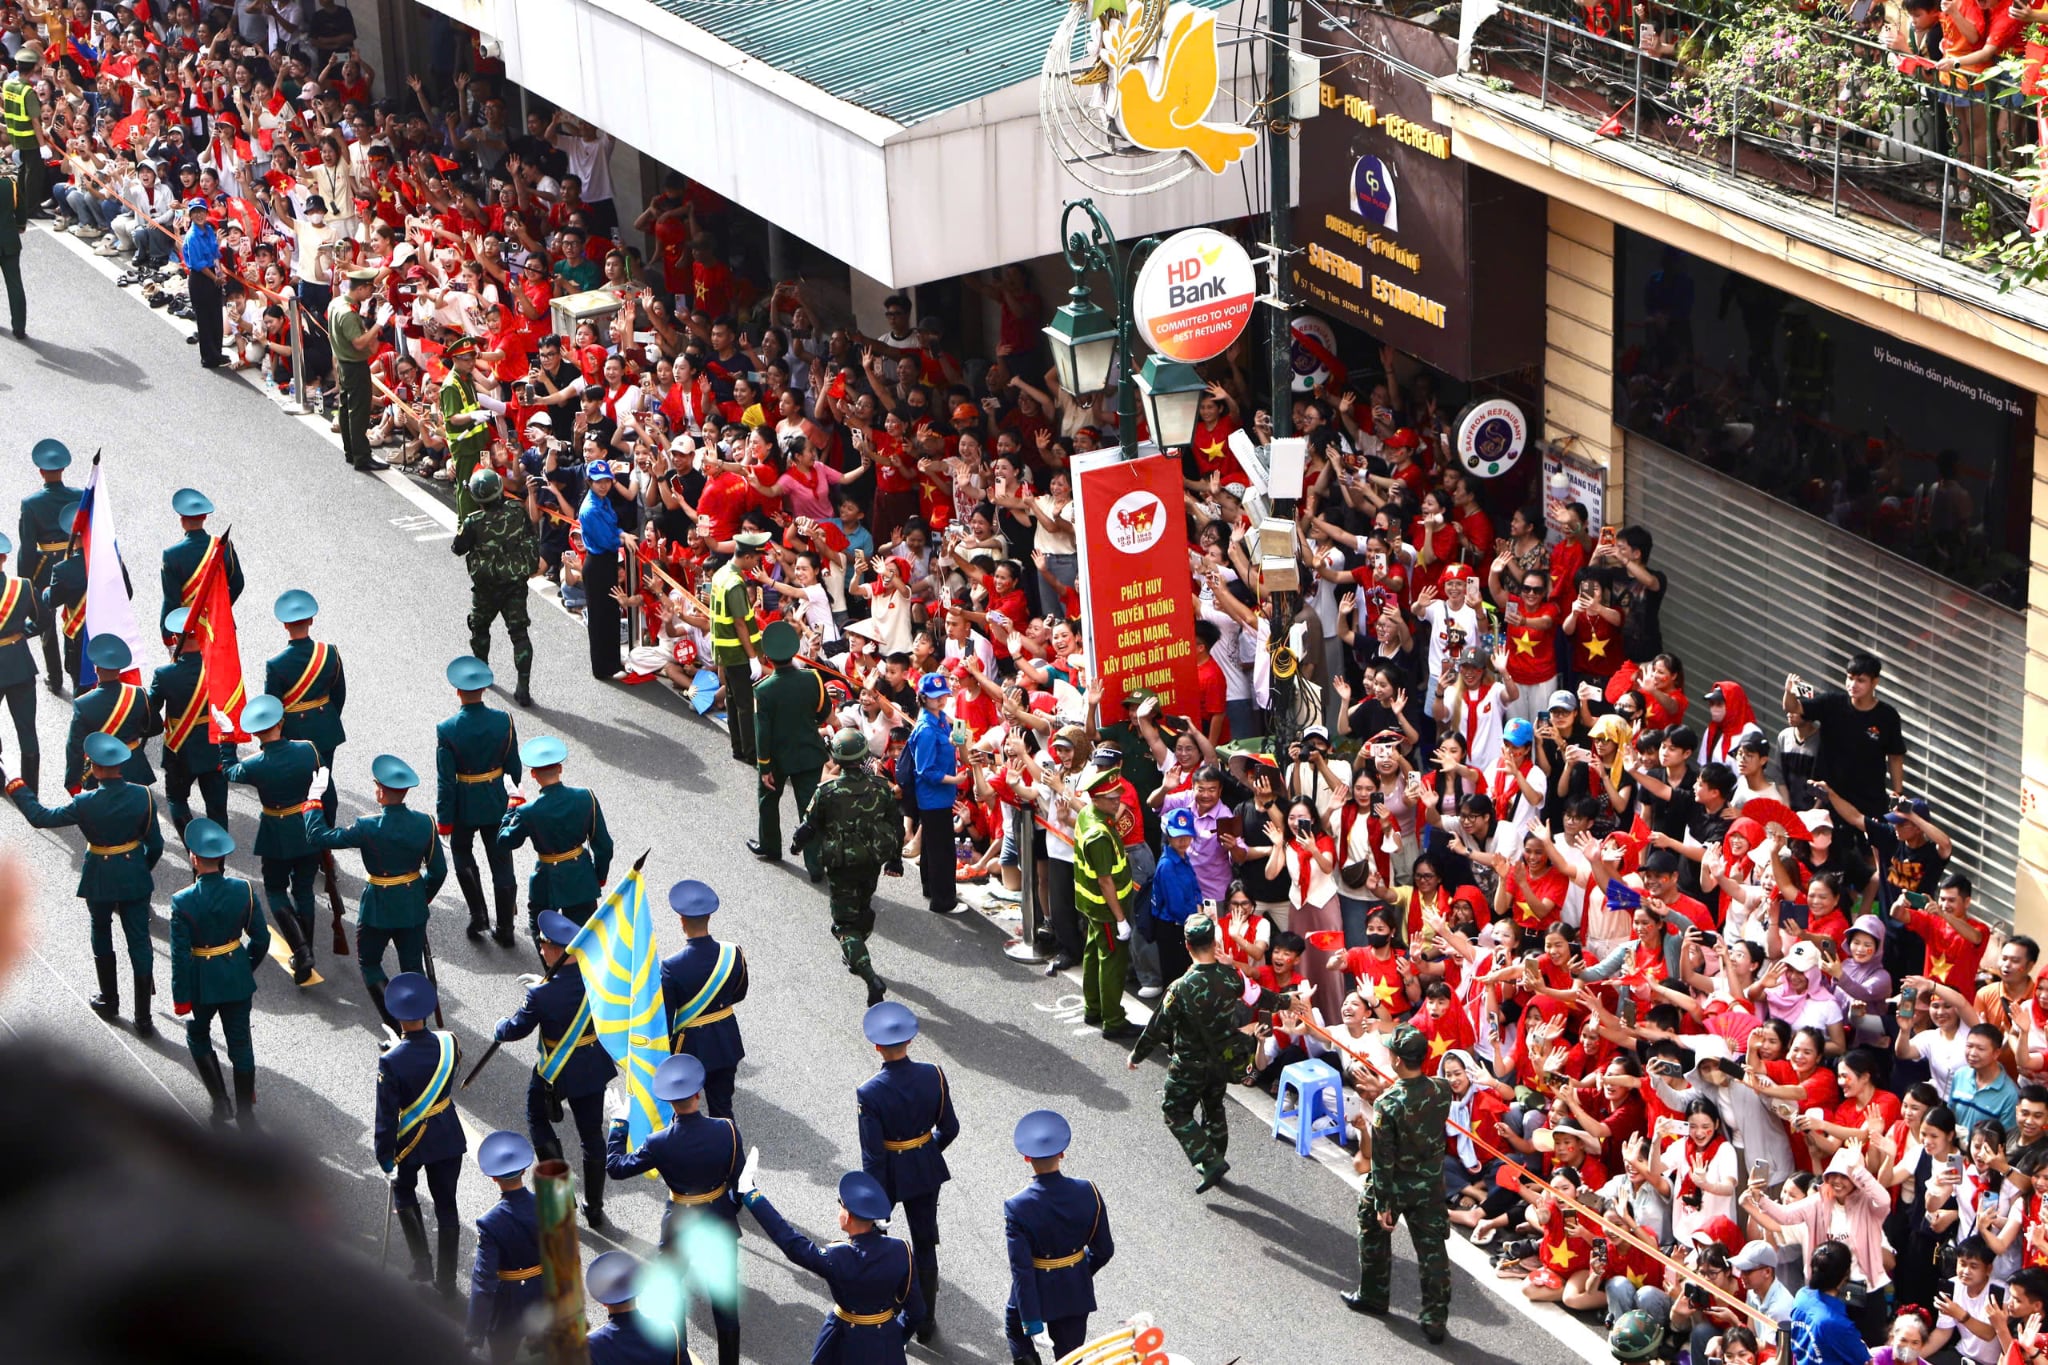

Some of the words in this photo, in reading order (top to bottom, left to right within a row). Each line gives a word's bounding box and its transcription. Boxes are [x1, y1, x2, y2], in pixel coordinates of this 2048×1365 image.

[1320, 81, 1336, 109] EL
[1344, 94, 1376, 128] FOOD
[1385, 113, 1450, 159] ICECREAM
[1167, 257, 1202, 285] HD
[1308, 242, 1363, 289] SAFFRON
[1169, 276, 1227, 308] Bank
[1300, 278, 1307, 289] 57
[1156, 313, 1209, 334] COMMITTED
[1210, 308, 1222, 320] TO
[1223, 303, 1248, 317] YOUR
[1173, 330, 1194, 343] BEST
[1195, 321, 1233, 337] RETURNS
[1886, 350, 1902, 367] ban
[1903, 358, 1925, 376] nhân
[1926, 368, 1943, 383] dân
[1943, 376, 1977, 400] phường
[1977, 388, 2003, 411] Tràng
[1466, 412, 1486, 452] SAFFRON
[1487, 408, 1521, 441] RESTAURANT
[1121, 580, 1143, 602] PHÁT
[1145, 578, 1162, 595] HUY
[1112, 602, 1144, 627] TRUYỀN
[1146, 597, 1175, 619] THỐNG
[1118, 628, 1141, 648] CÁCH
[1143, 622, 1173, 643] MẠNG,
[1103, 656, 1120, 676] XÂY
[1122, 650, 1146, 672] DỰNG
[1148, 644, 1165, 664] ĐẤT
[1166, 638, 1191, 660] NƯỚC
[1122, 673, 1143, 693] GIÀU
[1144, 668, 1175, 689] MẠNH,
